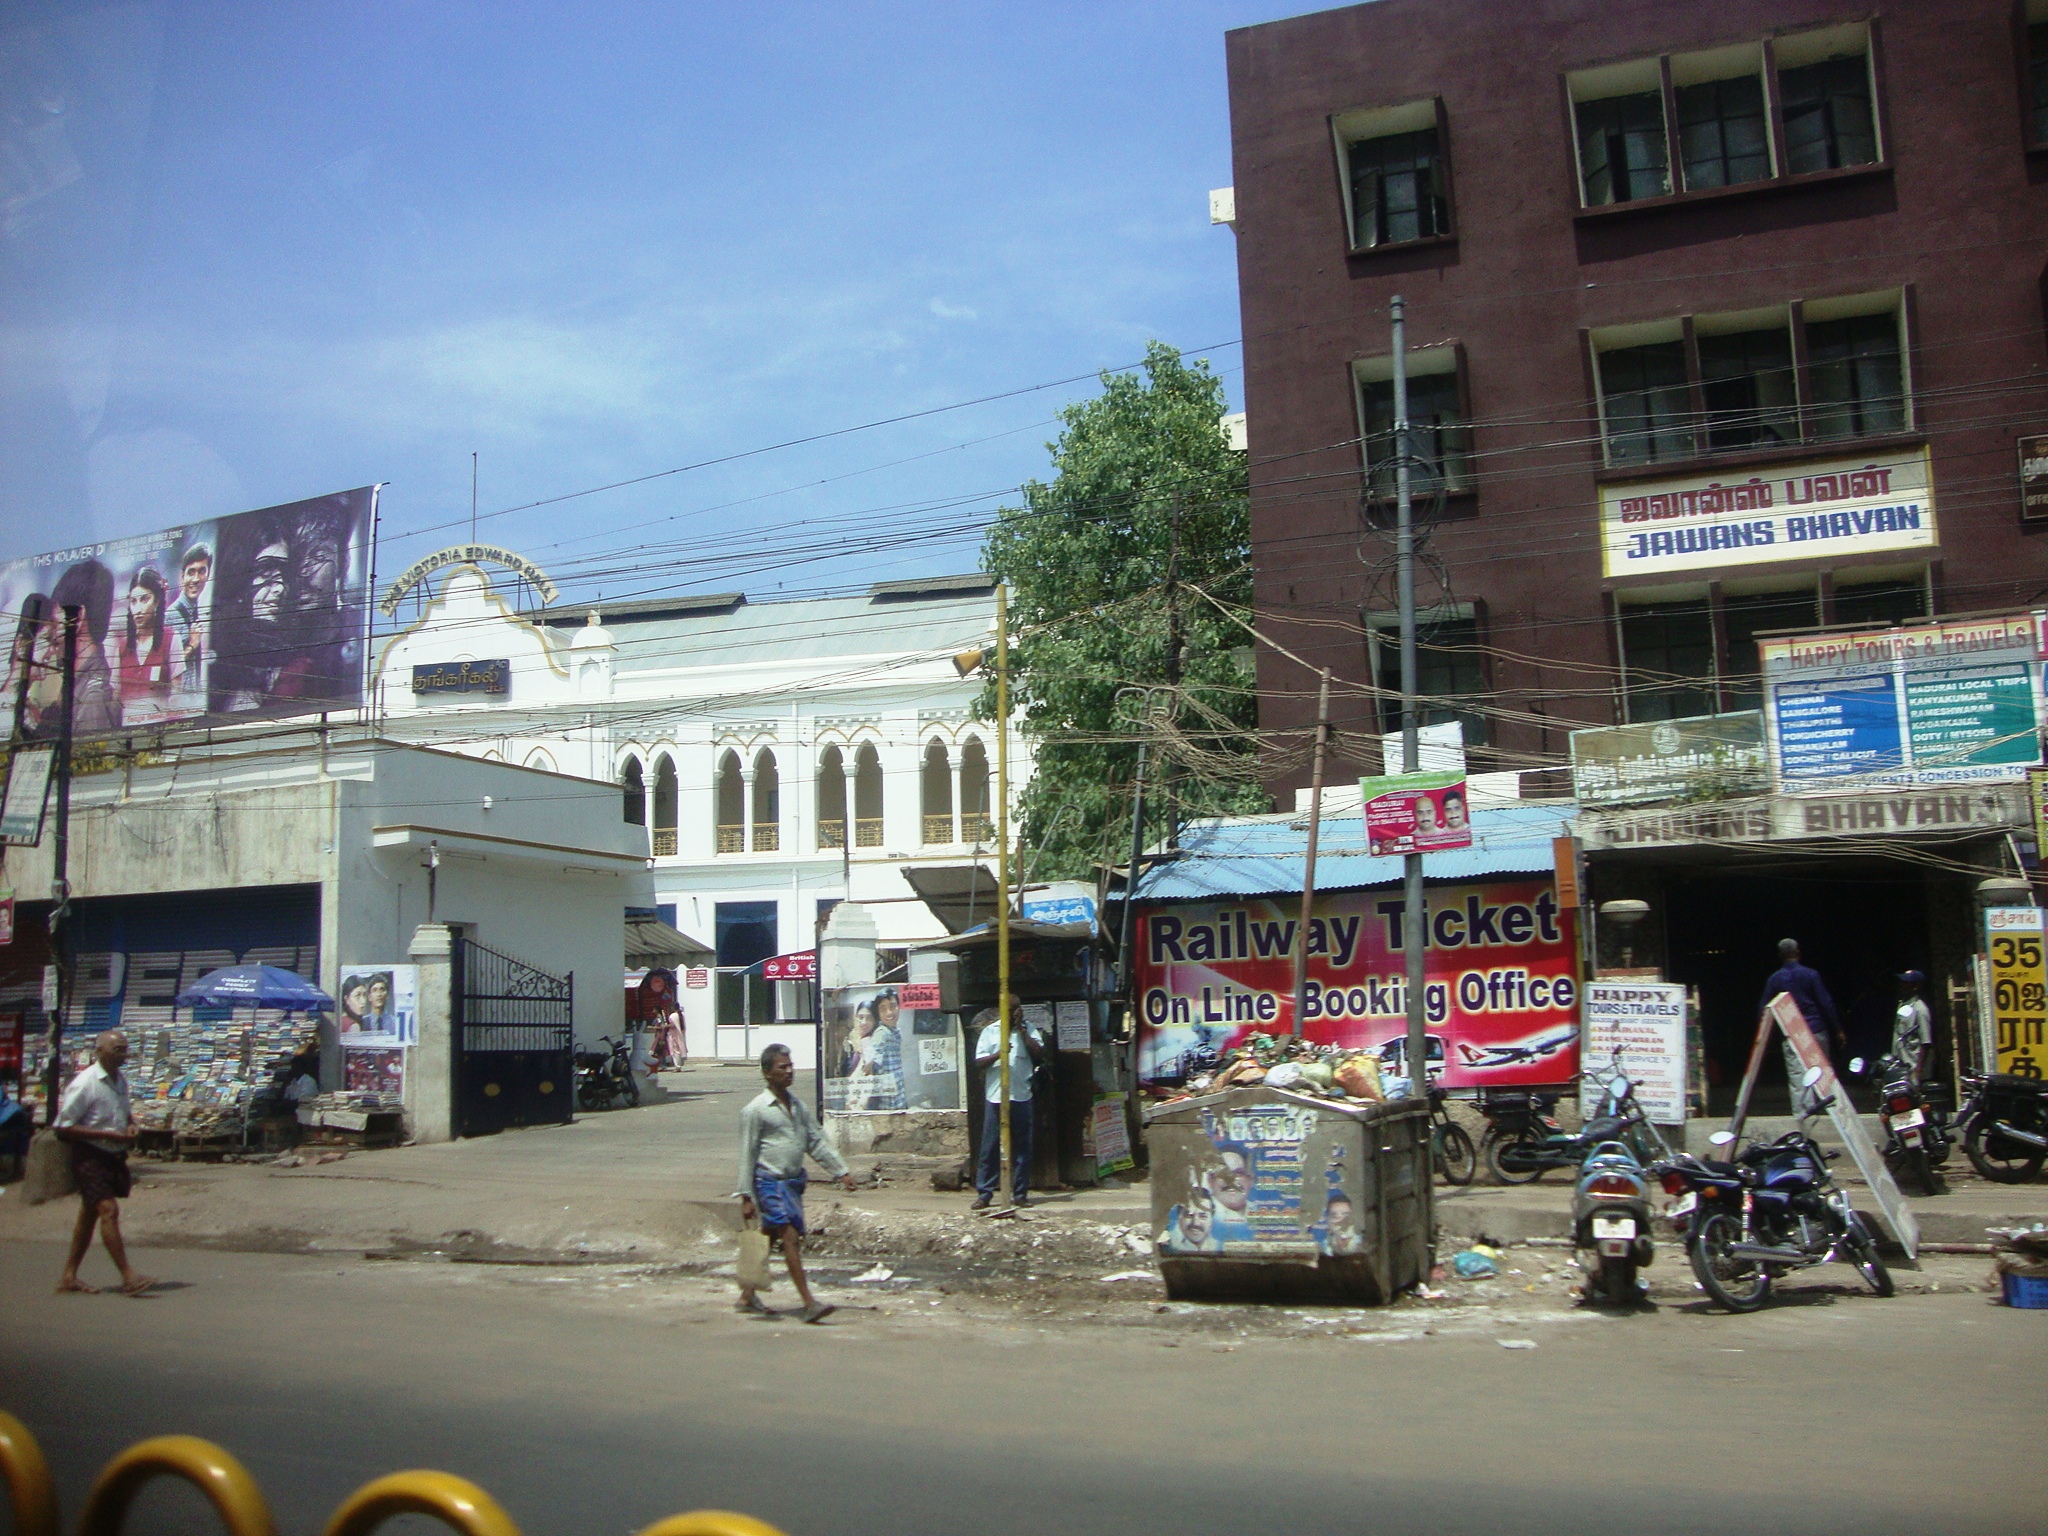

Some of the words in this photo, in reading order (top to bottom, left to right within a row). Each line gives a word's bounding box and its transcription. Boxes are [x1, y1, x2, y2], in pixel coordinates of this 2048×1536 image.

[1785, 463, 1892, 505] பவன்
[1627, 520, 1775, 559] JAWANS
[1786, 504, 1920, 542] BHAVAN
[33, 554, 52, 568] THIS
[401, 548, 462, 587] VICTORIA
[465, 546, 523, 570] EDWARD
[1790, 643, 1850, 669] HAPPY
[1855, 635, 1917, 662] TOURS
[1925, 634, 1936, 657] &
[1943, 626, 2027, 654] TRAVELS
[1907, 683, 1957, 694] MADURAI
[1959, 679, 1994, 690] LOCAL
[1996, 676, 2029, 687] TRIPS
[1779, 695, 1825, 706] CHENNAI
[1909, 692, 1988, 706] KANYAKUMARI
[1780, 705, 1843, 718] BANGALORE
[1910, 703, 1995, 718] RAMESHWARAM
[1782, 728, 1855, 741] PONDICHERRY
[1912, 732, 1942, 742] OOTY
[1949, 728, 1995, 739] MYSORE
[1832, 749, 1878, 761] CALICUT
[1918, 767, 2003, 783] CONCESSION
[1804, 796, 1971, 832] BHAVAN
[1149, 911, 1360, 967] Railway
[1377, 892, 1560, 951] Ticket
[1992, 937, 2041, 969] 35
[213, 985, 256, 993] NEWSPAPER
[1145, 986, 1190, 1025] On
[1202, 985, 1277, 1022] Line
[1302, 976, 1446, 1025] Bookig
[1460, 967, 1575, 1012] Office
[1592, 989, 1672, 1002] HAPPY
[930, 1051, 943, 1060] 30
[1627, 1056, 1659, 1064] SERVICE
